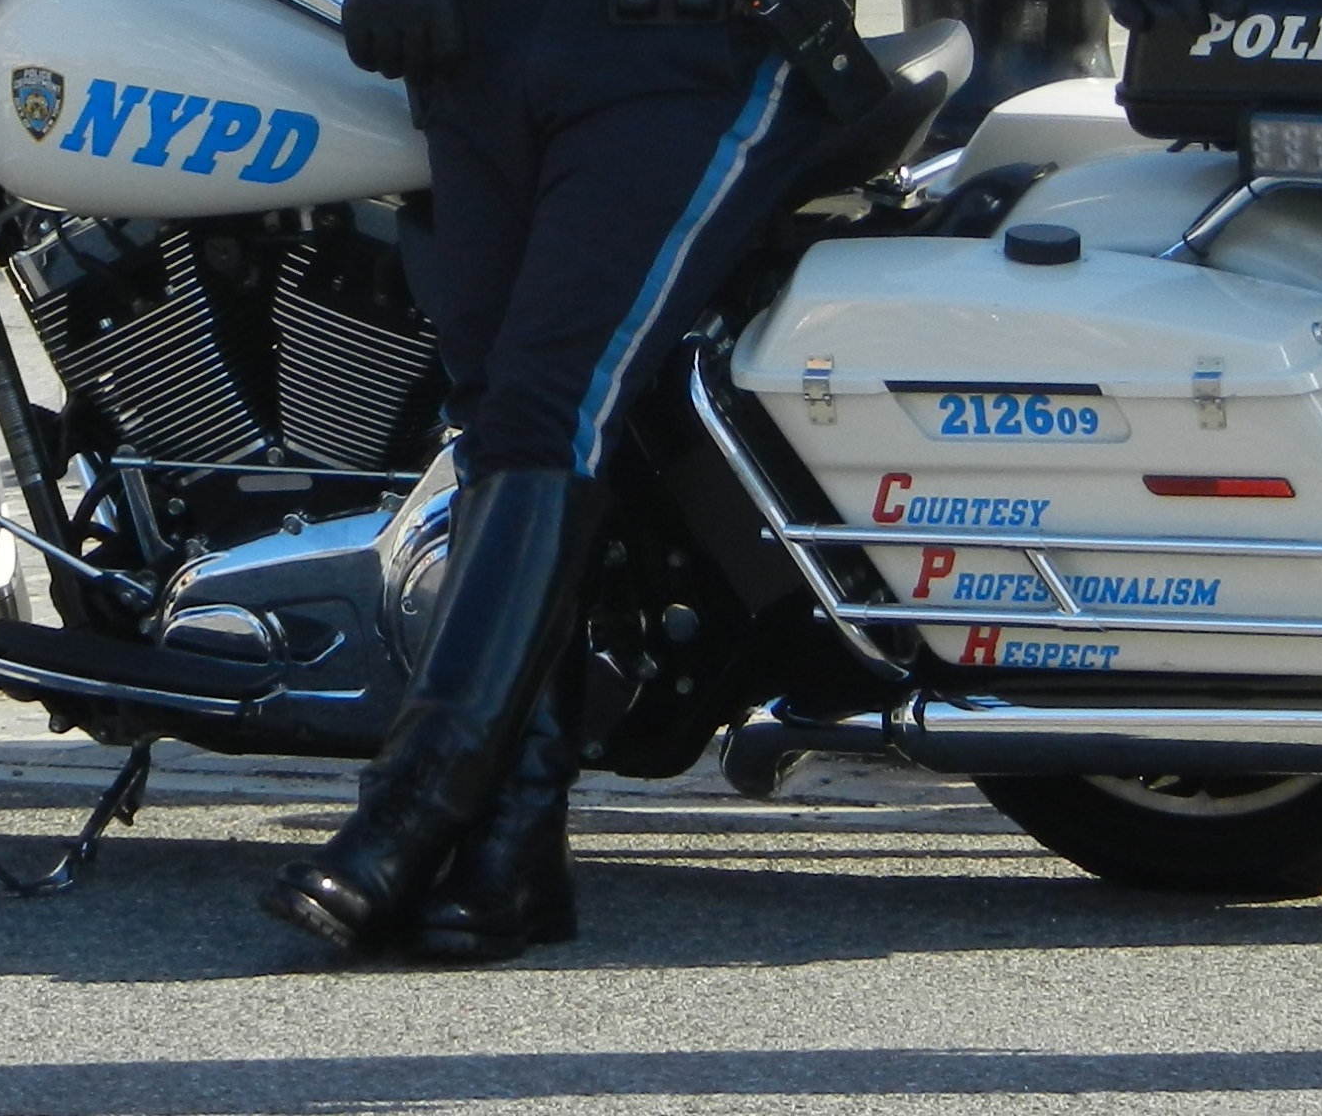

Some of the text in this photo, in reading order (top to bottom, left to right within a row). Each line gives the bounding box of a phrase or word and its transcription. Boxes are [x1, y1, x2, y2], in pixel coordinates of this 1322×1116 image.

[60, 79, 320, 184] NYPD
[939, 394, 1099, 436] 212609
[912, 546, 1221, 607] PROFESIONALISM
